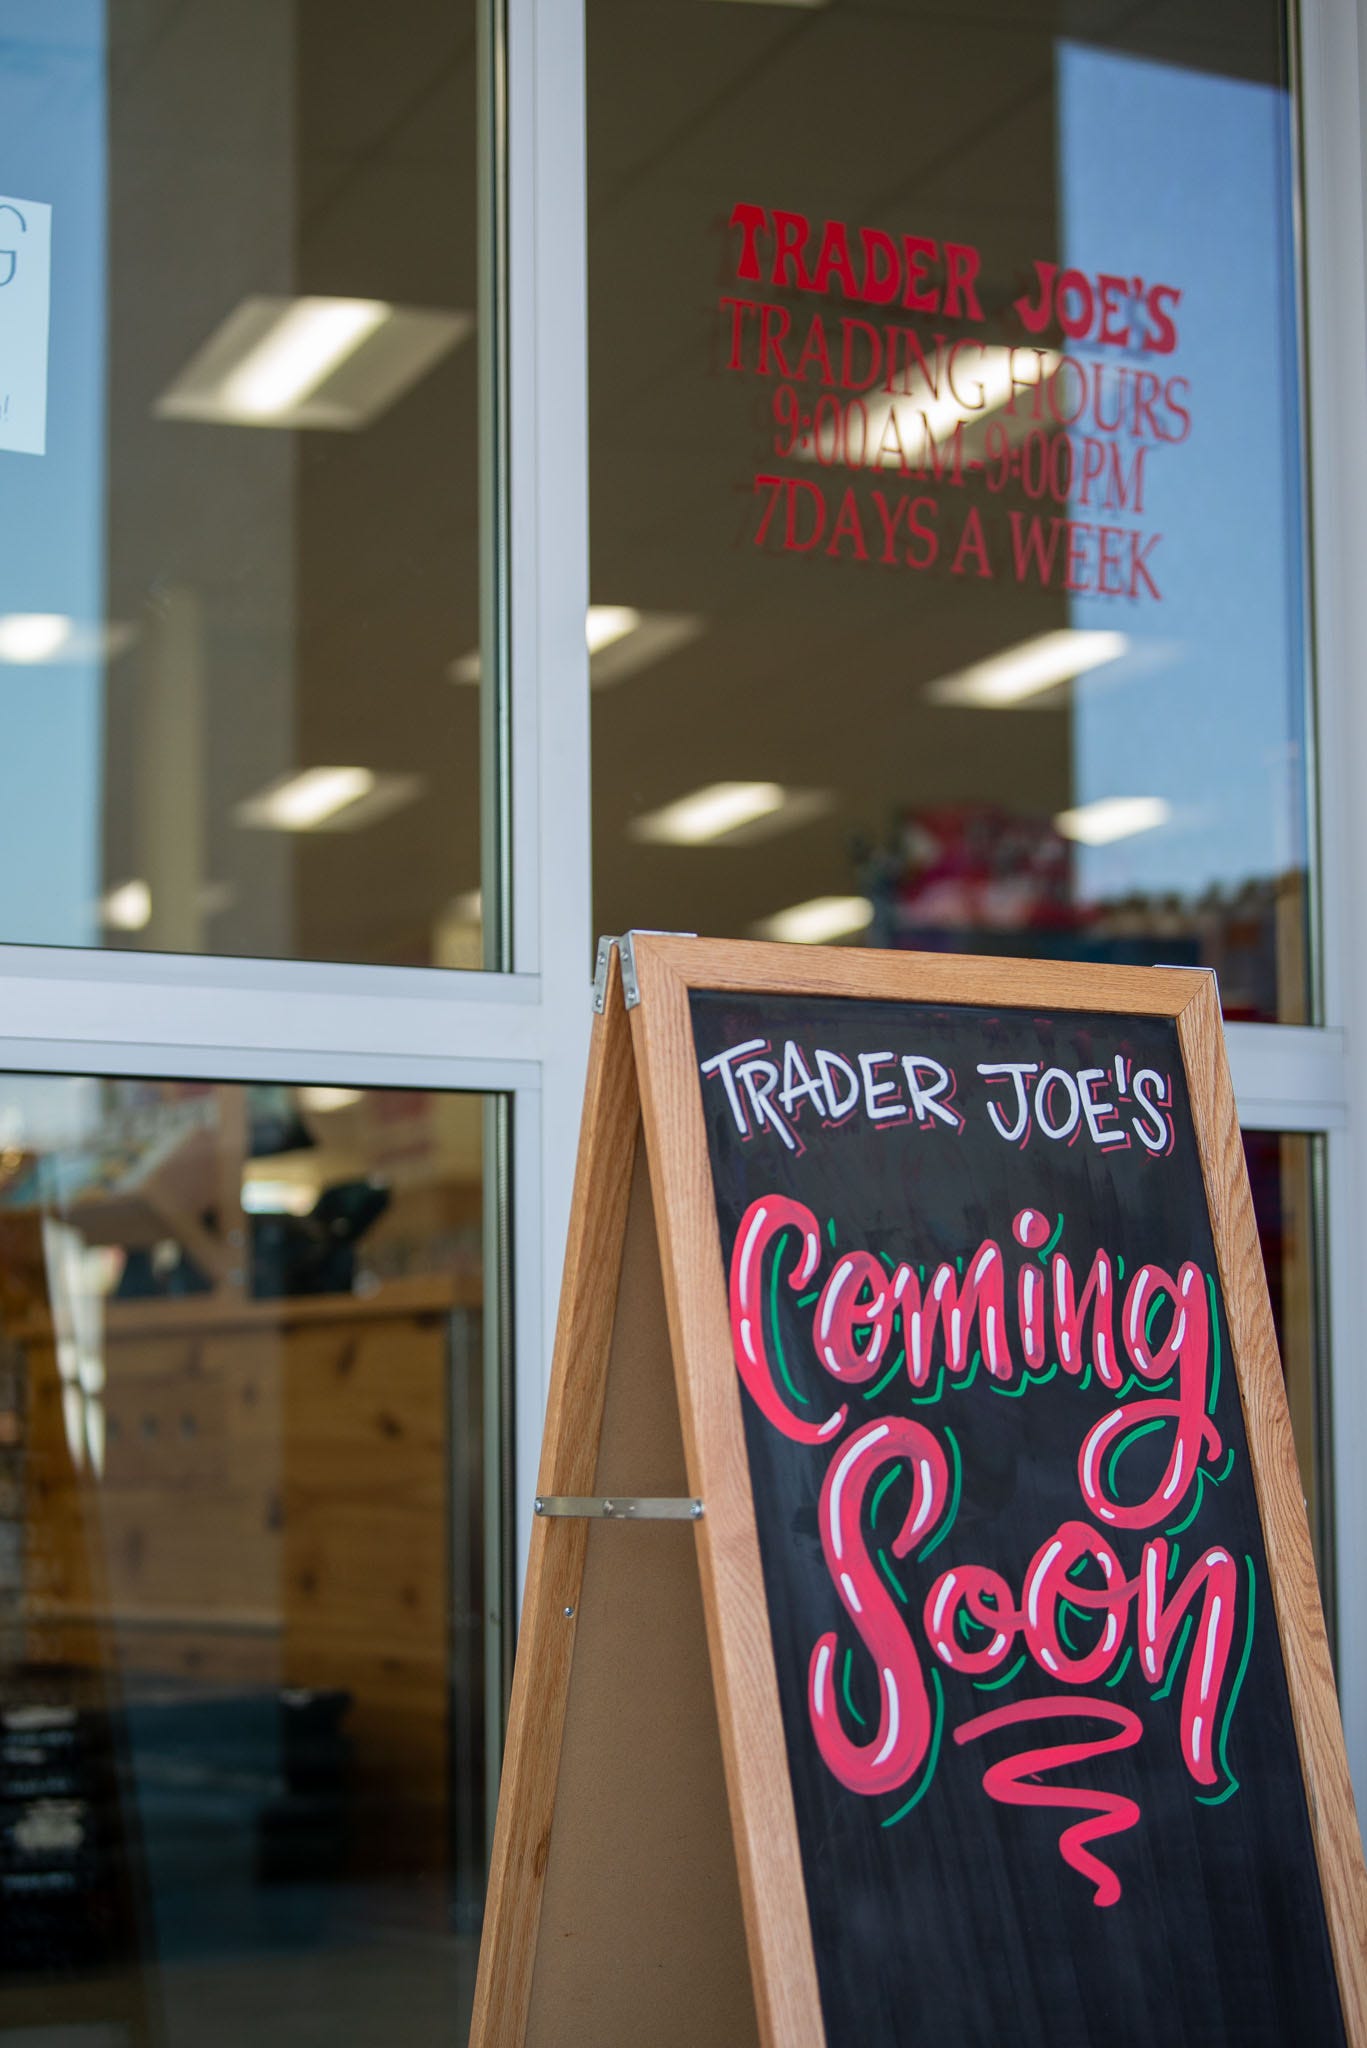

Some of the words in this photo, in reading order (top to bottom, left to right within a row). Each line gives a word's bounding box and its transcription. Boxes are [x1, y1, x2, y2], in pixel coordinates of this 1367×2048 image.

[728, 203, 985, 321] TRADER
[1015, 261, 1181, 354] JOE'S
[720, 297, 987, 411] TRADING
[1005, 347, 1191, 444] HOURS
[952, 506, 993, 579] A
[1009, 511, 1163, 601] WEEK
[702, 1039, 963, 1153] TRADER
[977, 1055, 1171, 1154] JOE'S
[730, 1194, 1224, 1529] Coming
[808, 1416, 1237, 1796] Soon
